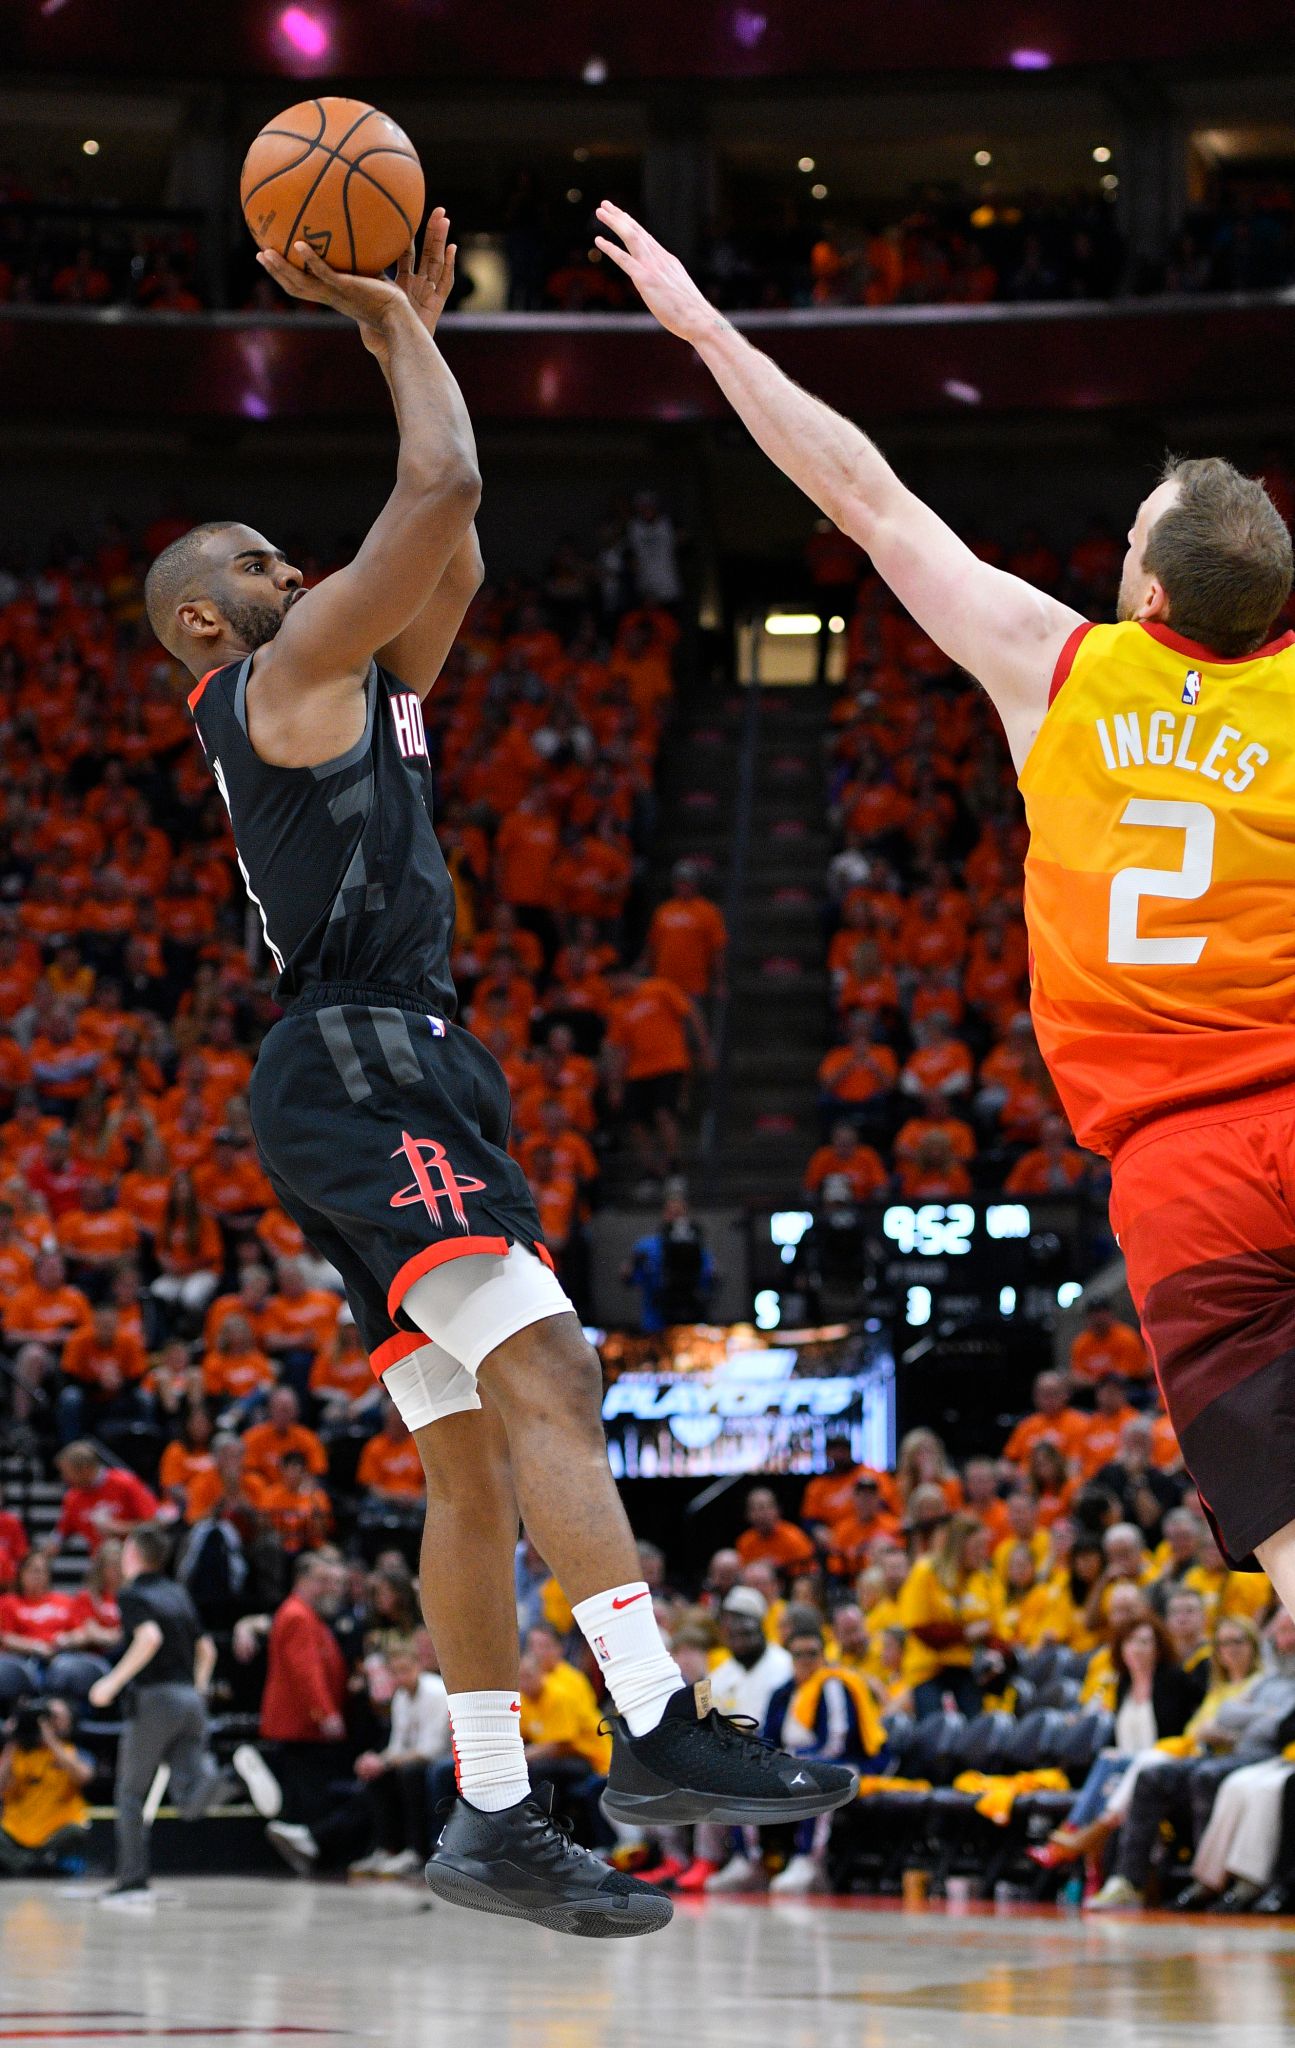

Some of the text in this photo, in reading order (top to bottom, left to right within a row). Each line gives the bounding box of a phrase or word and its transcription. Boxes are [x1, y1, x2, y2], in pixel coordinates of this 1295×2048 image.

[389, 691, 431, 767] HO
[1095, 709, 1270, 793] INGLES
[1107, 797, 1216, 965] 2
